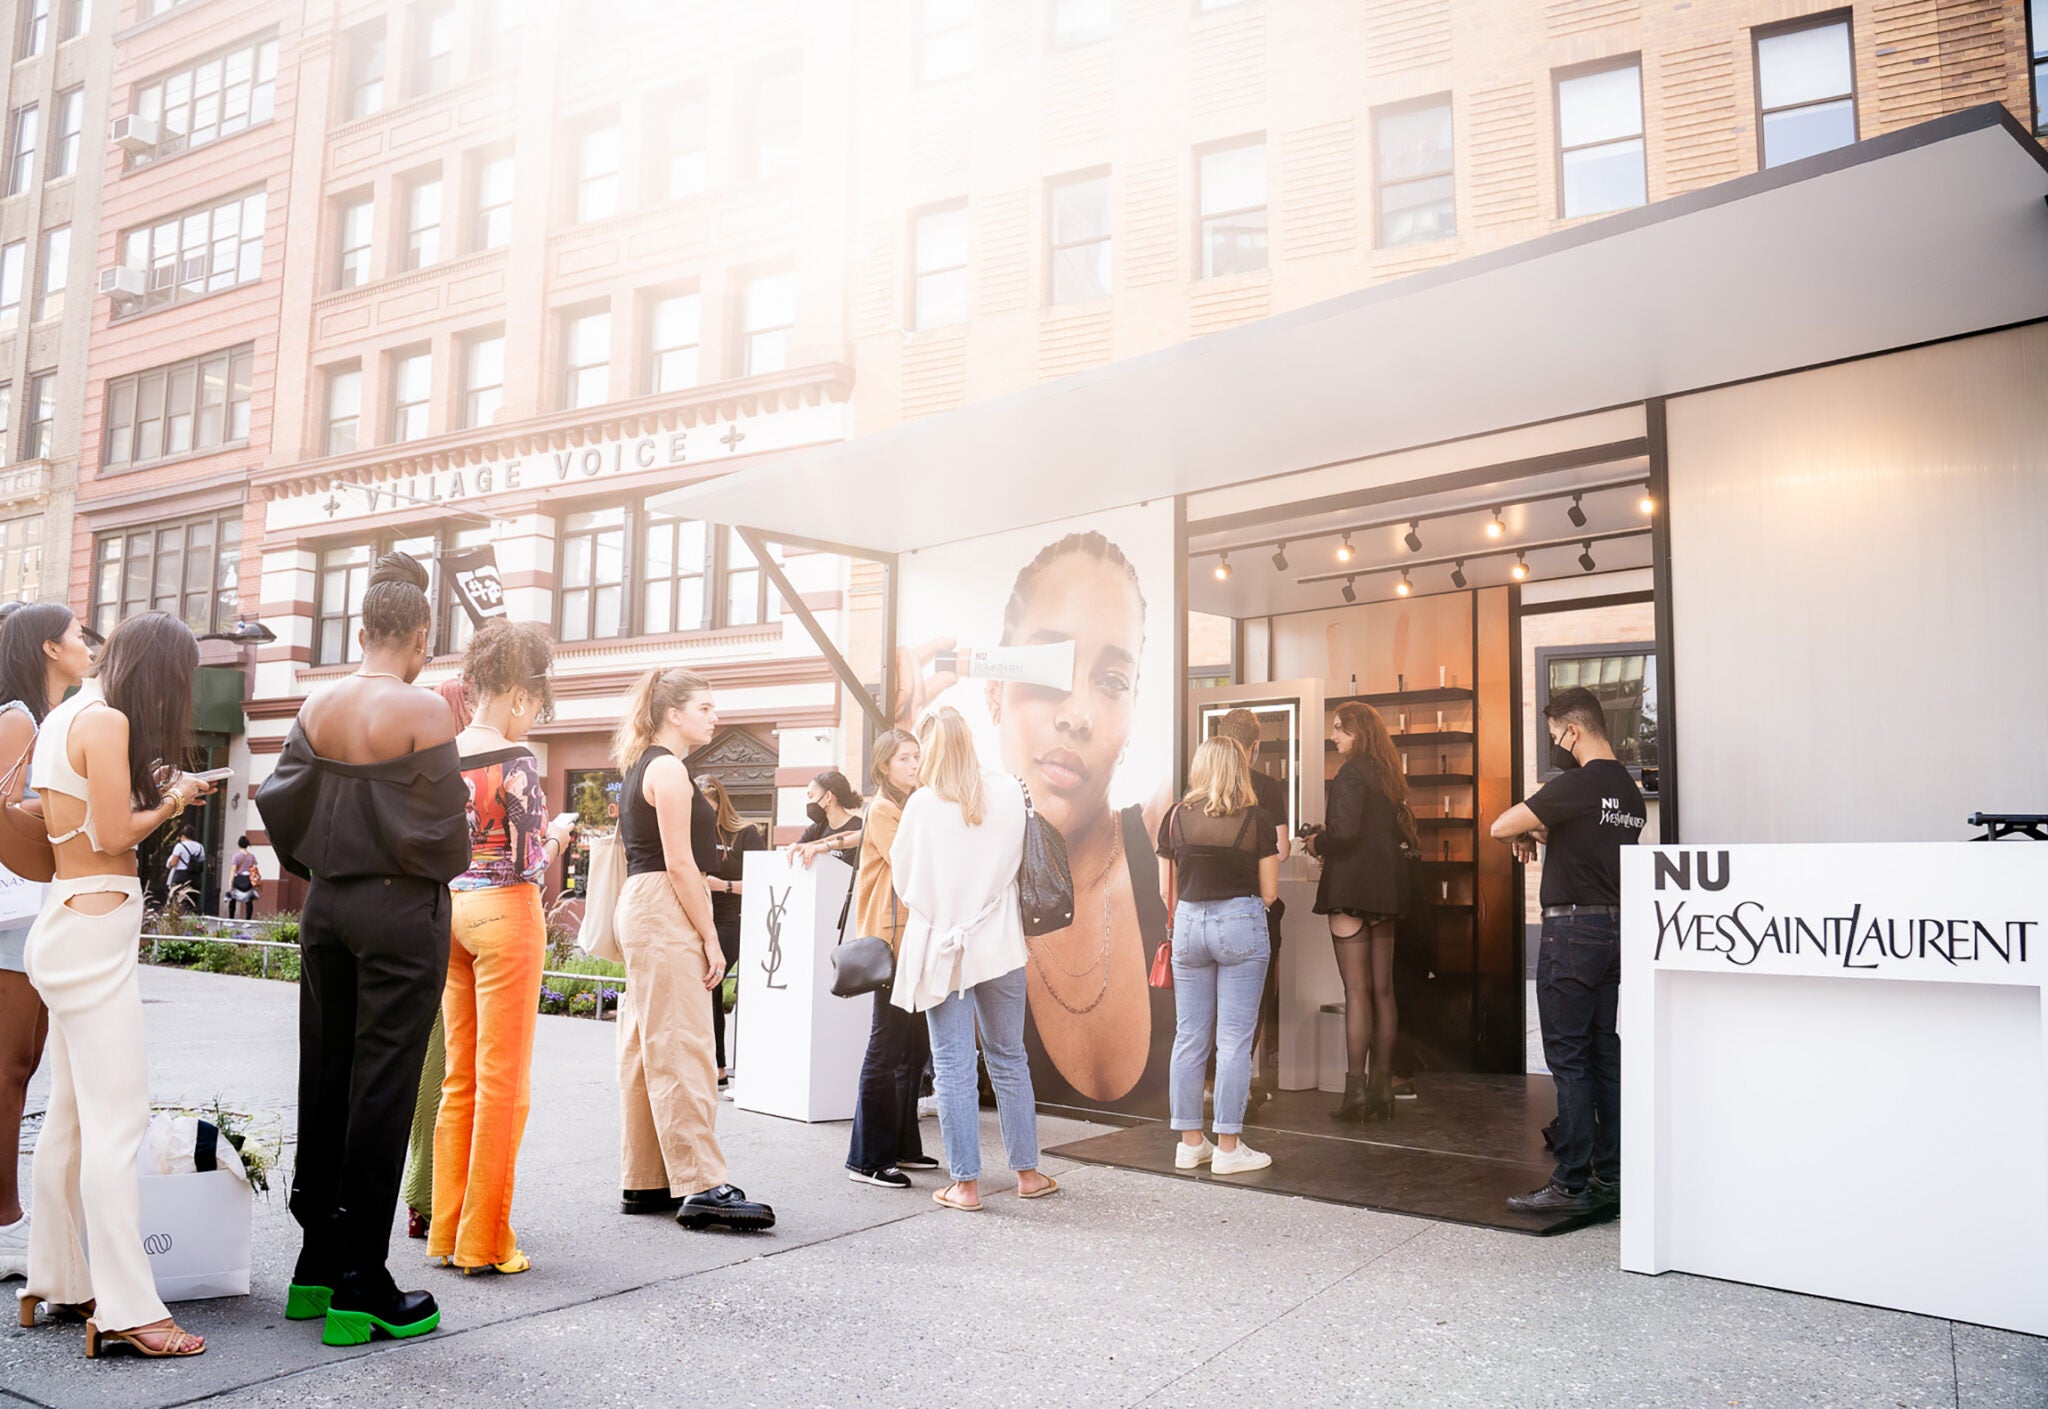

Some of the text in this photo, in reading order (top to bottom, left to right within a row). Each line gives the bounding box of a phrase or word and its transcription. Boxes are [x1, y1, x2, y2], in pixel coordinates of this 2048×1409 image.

[366, 432, 687, 512] VILLAGE VOICE
[1601, 798, 1620, 809] NU
[1652, 850, 1731, 892] NU
